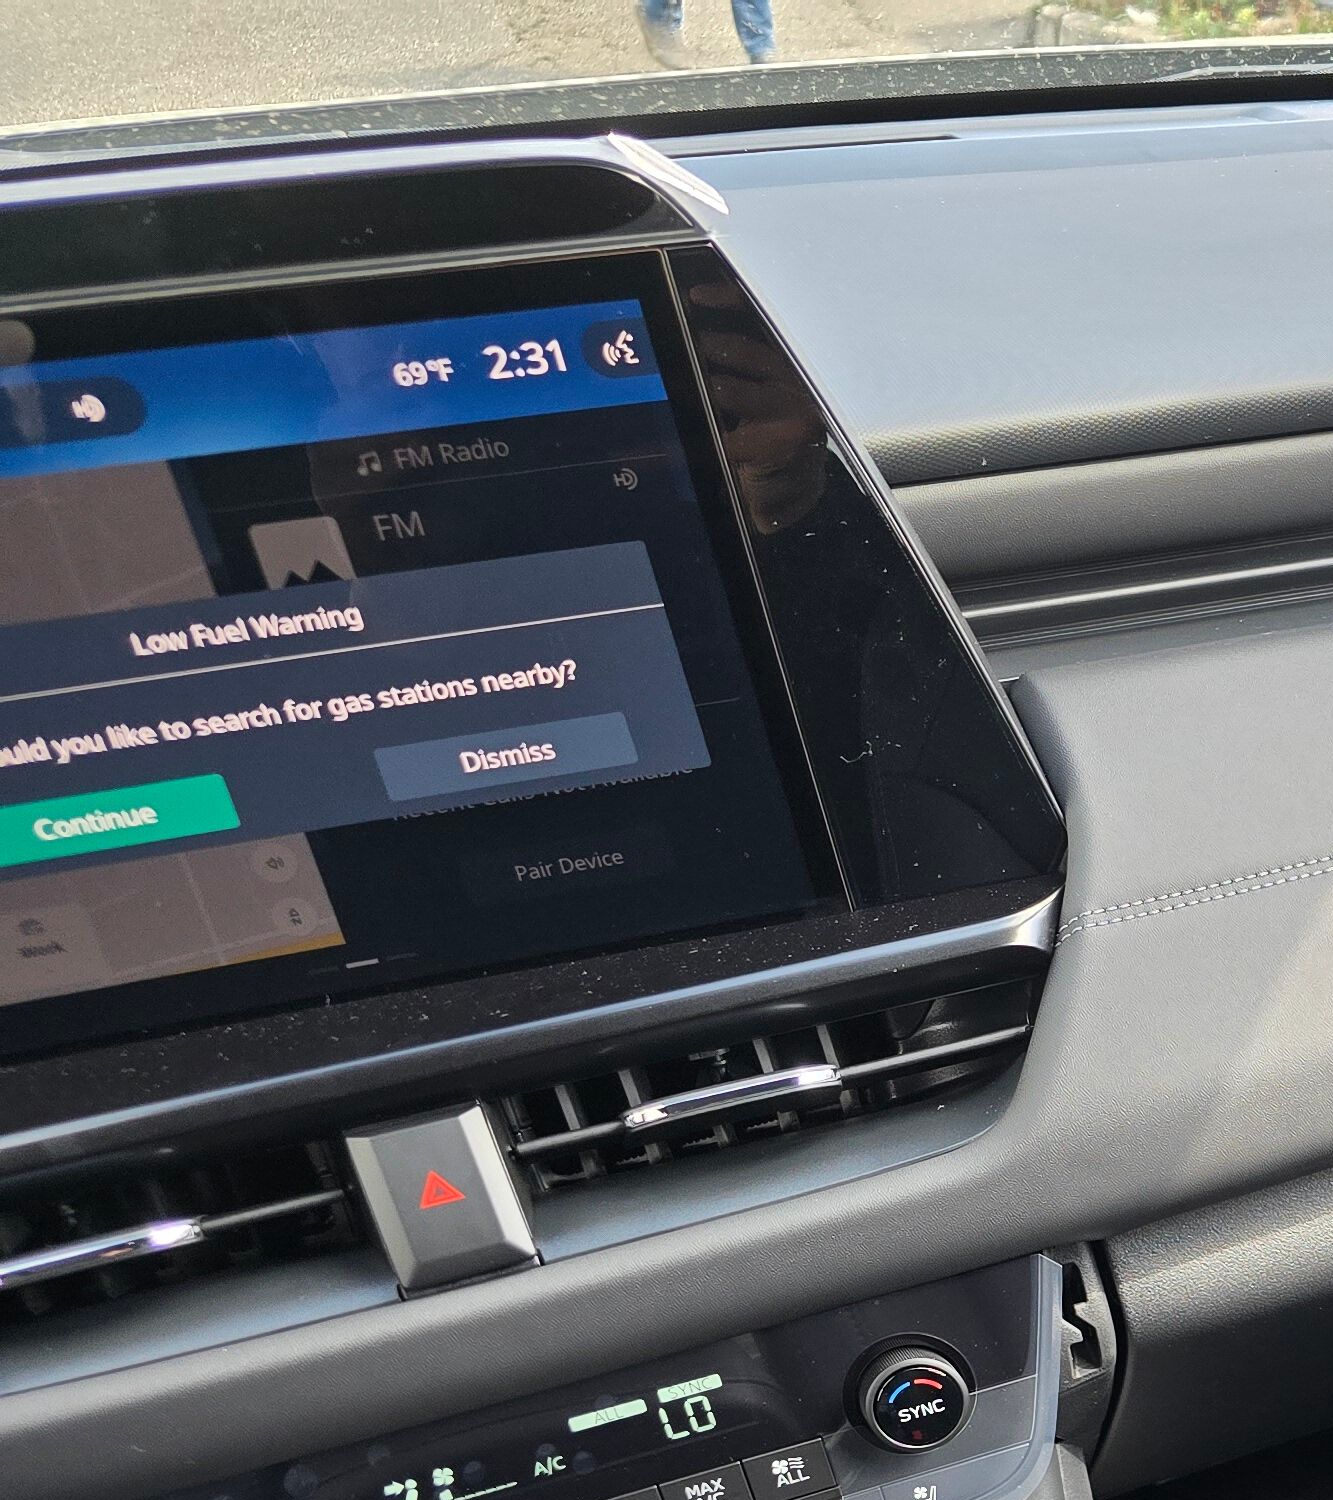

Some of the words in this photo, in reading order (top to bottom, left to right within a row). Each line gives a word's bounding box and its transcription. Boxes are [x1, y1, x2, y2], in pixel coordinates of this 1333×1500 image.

[392, 357, 454, 387] 69°F
[481, 339, 567, 380] 2:31
[393, 446, 433, 470] FM
[439, 437, 511, 466] Radio
[372, 511, 426, 542] FM
[129, 630, 189, 657] Low
[189, 616, 251, 648] Fuel
[248, 605, 365, 640] Warning
[50, 733, 108, 764] you
[105, 722, 159, 749] like
[158, 720, 193, 742] to
[192, 703, 283, 737] search
[282, 698, 323, 724] for
[327, 692, 375, 722] gas
[377, 678, 478, 709] stations
[480, 659, 577, 694] nearby?
[458, 742, 557, 774] Dismiss
[33, 805, 159, 841] Continue
[514, 862, 553, 882] Pair
[558, 850, 625, 876] Device
[667, 1376, 714, 1399] SYNC
[595, 1407, 625, 1424] ALL
[898, 1398, 946, 1423] SYNC
[534, 1455, 567, 1477] A/C
[777, 1469, 810, 1488] ALL
[684, 1477, 726, 1500] MAX
